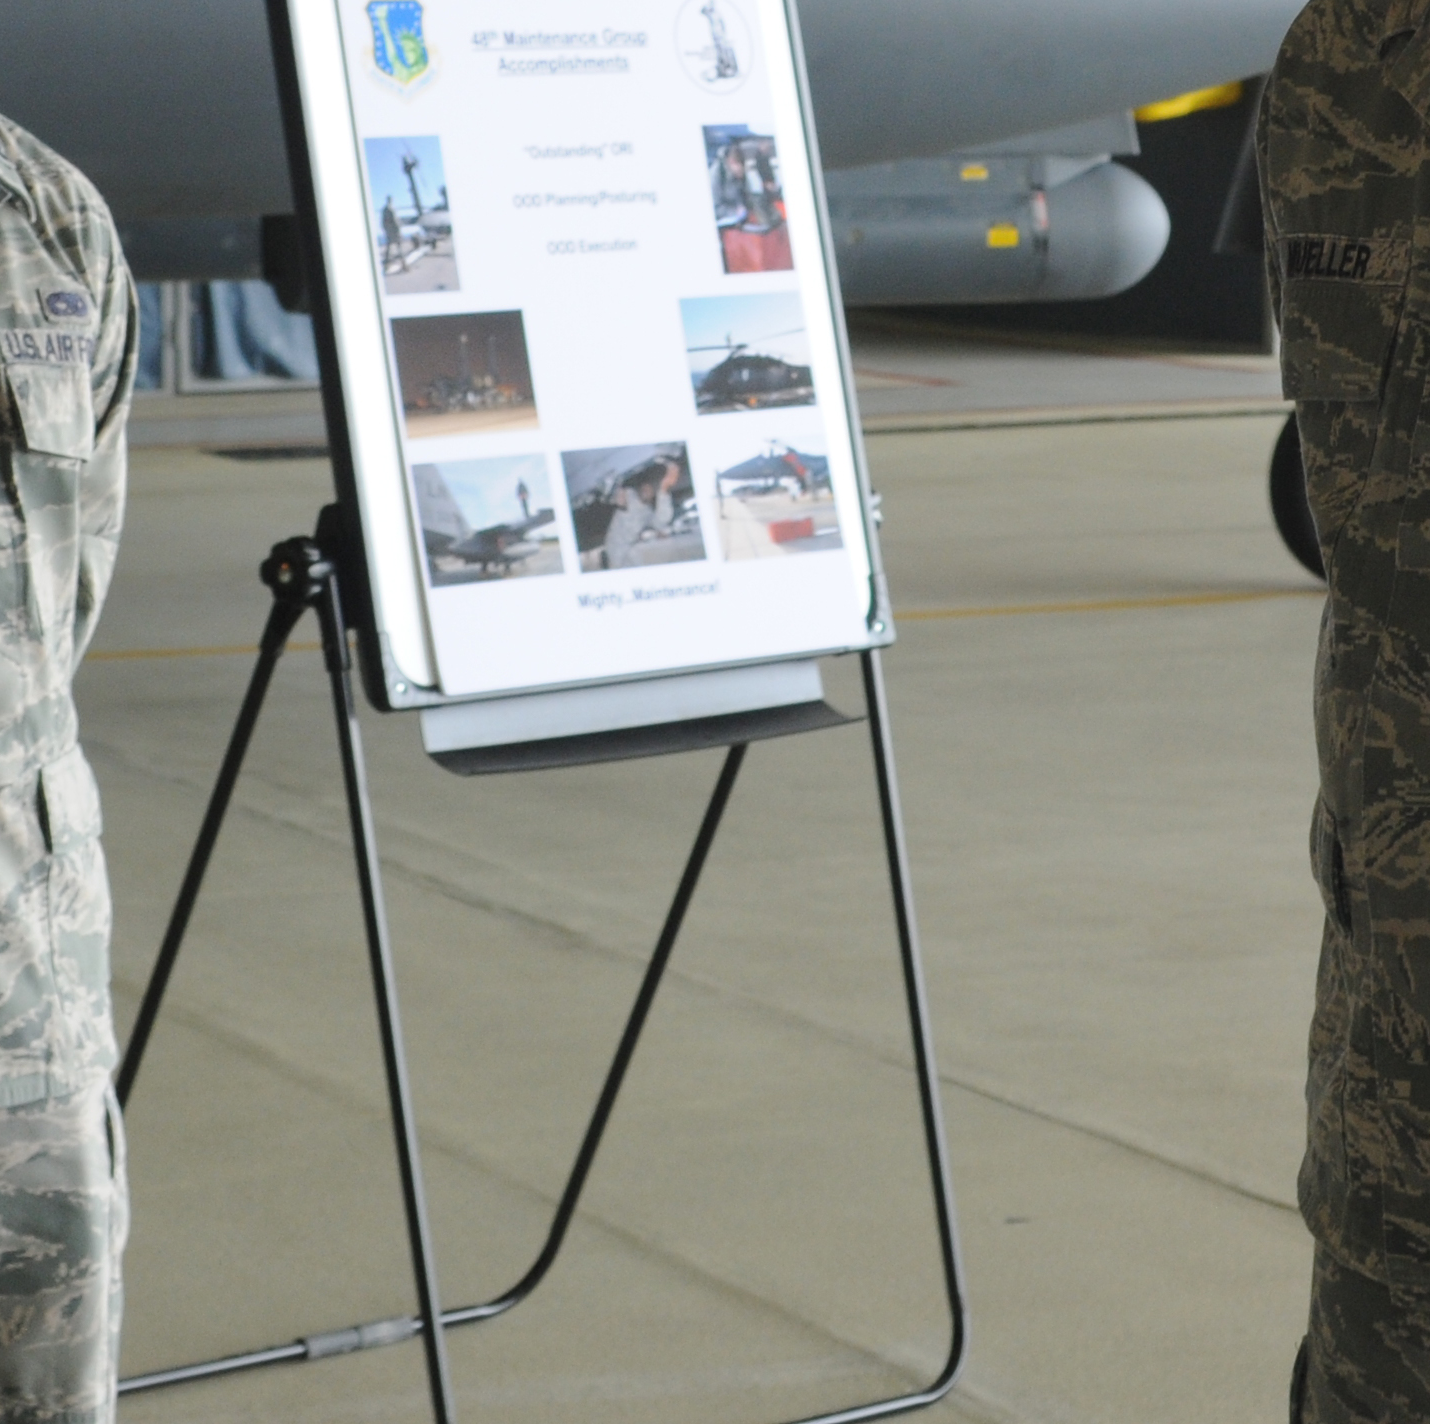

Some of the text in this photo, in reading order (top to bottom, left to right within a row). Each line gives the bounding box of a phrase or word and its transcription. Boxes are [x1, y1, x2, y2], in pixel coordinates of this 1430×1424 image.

[504, 30, 597, 47] Maintenance
[602, 28, 648, 47] Group
[499, 56, 630, 74] Accomplishments
[579, 238, 637, 254] Execution
